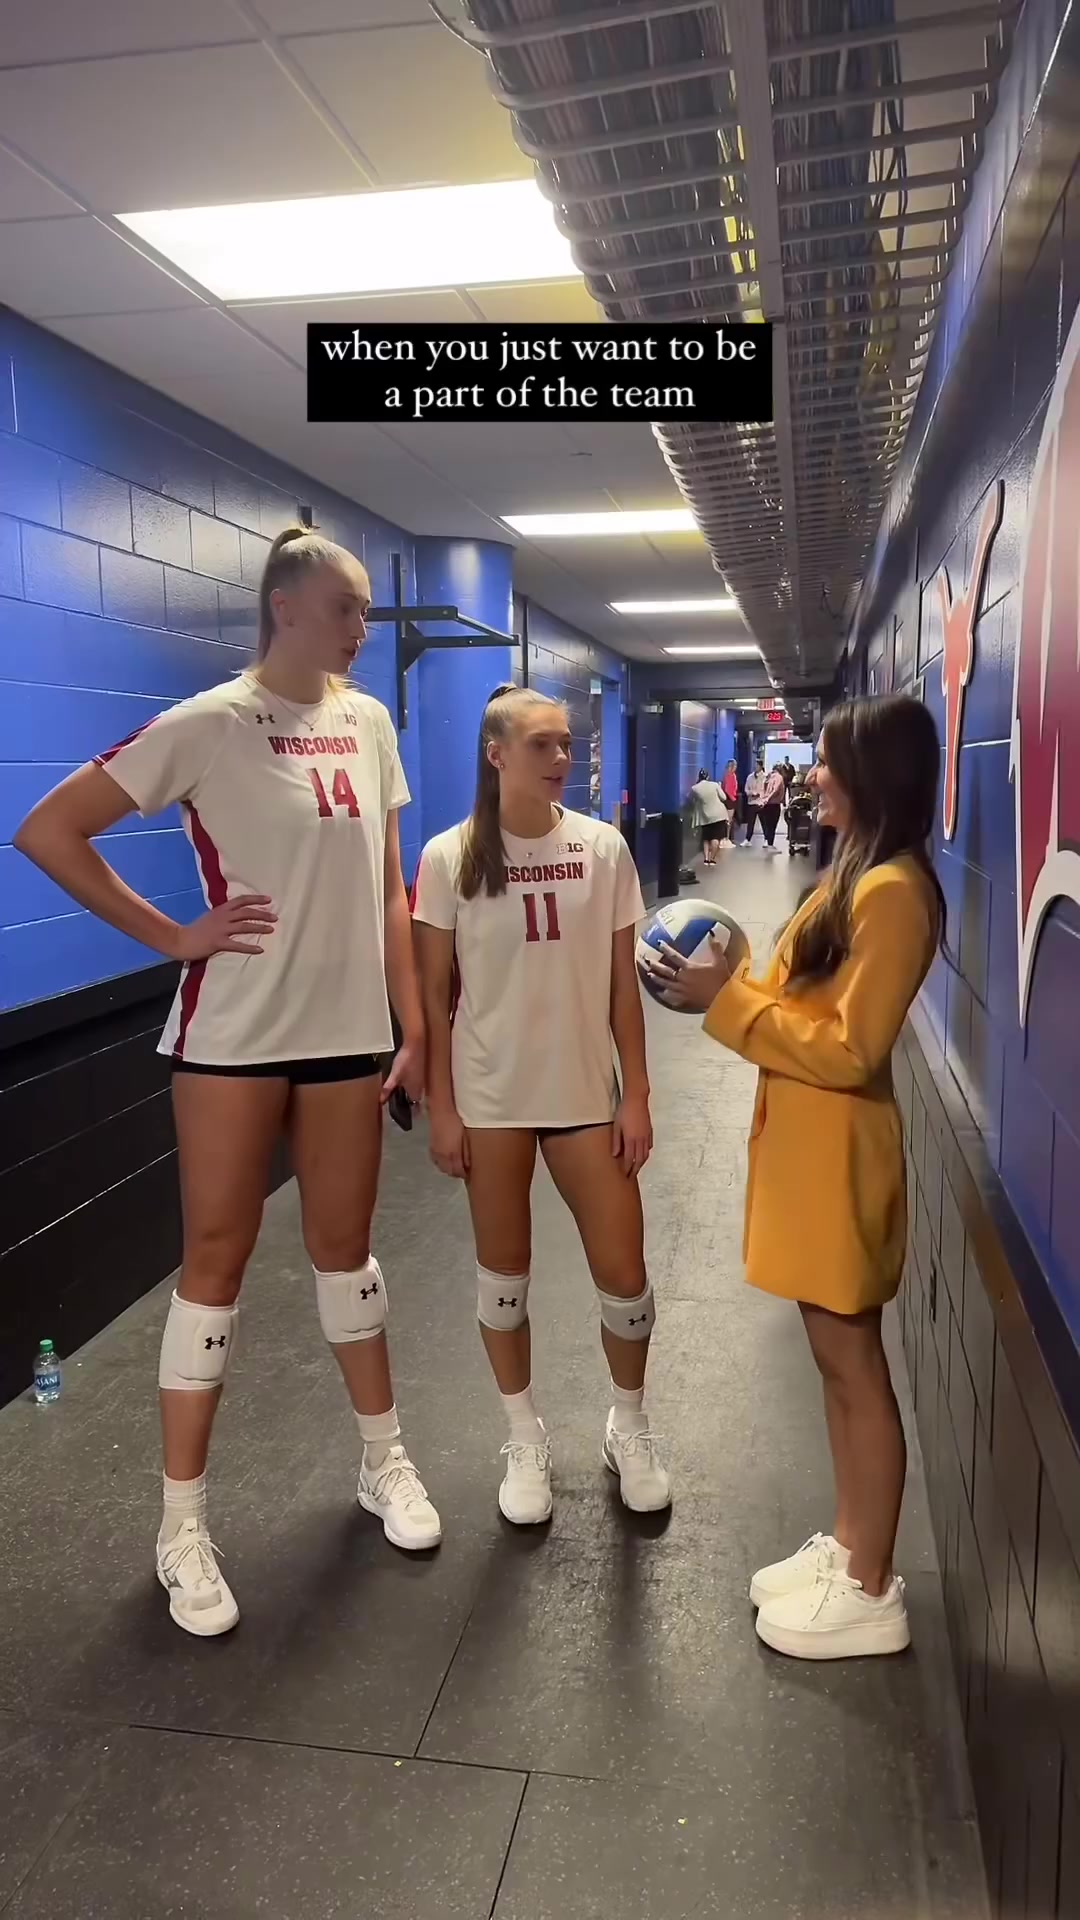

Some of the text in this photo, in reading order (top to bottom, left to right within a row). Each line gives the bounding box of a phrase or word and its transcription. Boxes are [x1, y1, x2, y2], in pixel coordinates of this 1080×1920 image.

[267, 735, 359, 756] WISCONSIN
[306, 767, 361, 818] 14
[503, 861, 584, 883] ISCONSIN
[522, 891, 561, 942] 11
